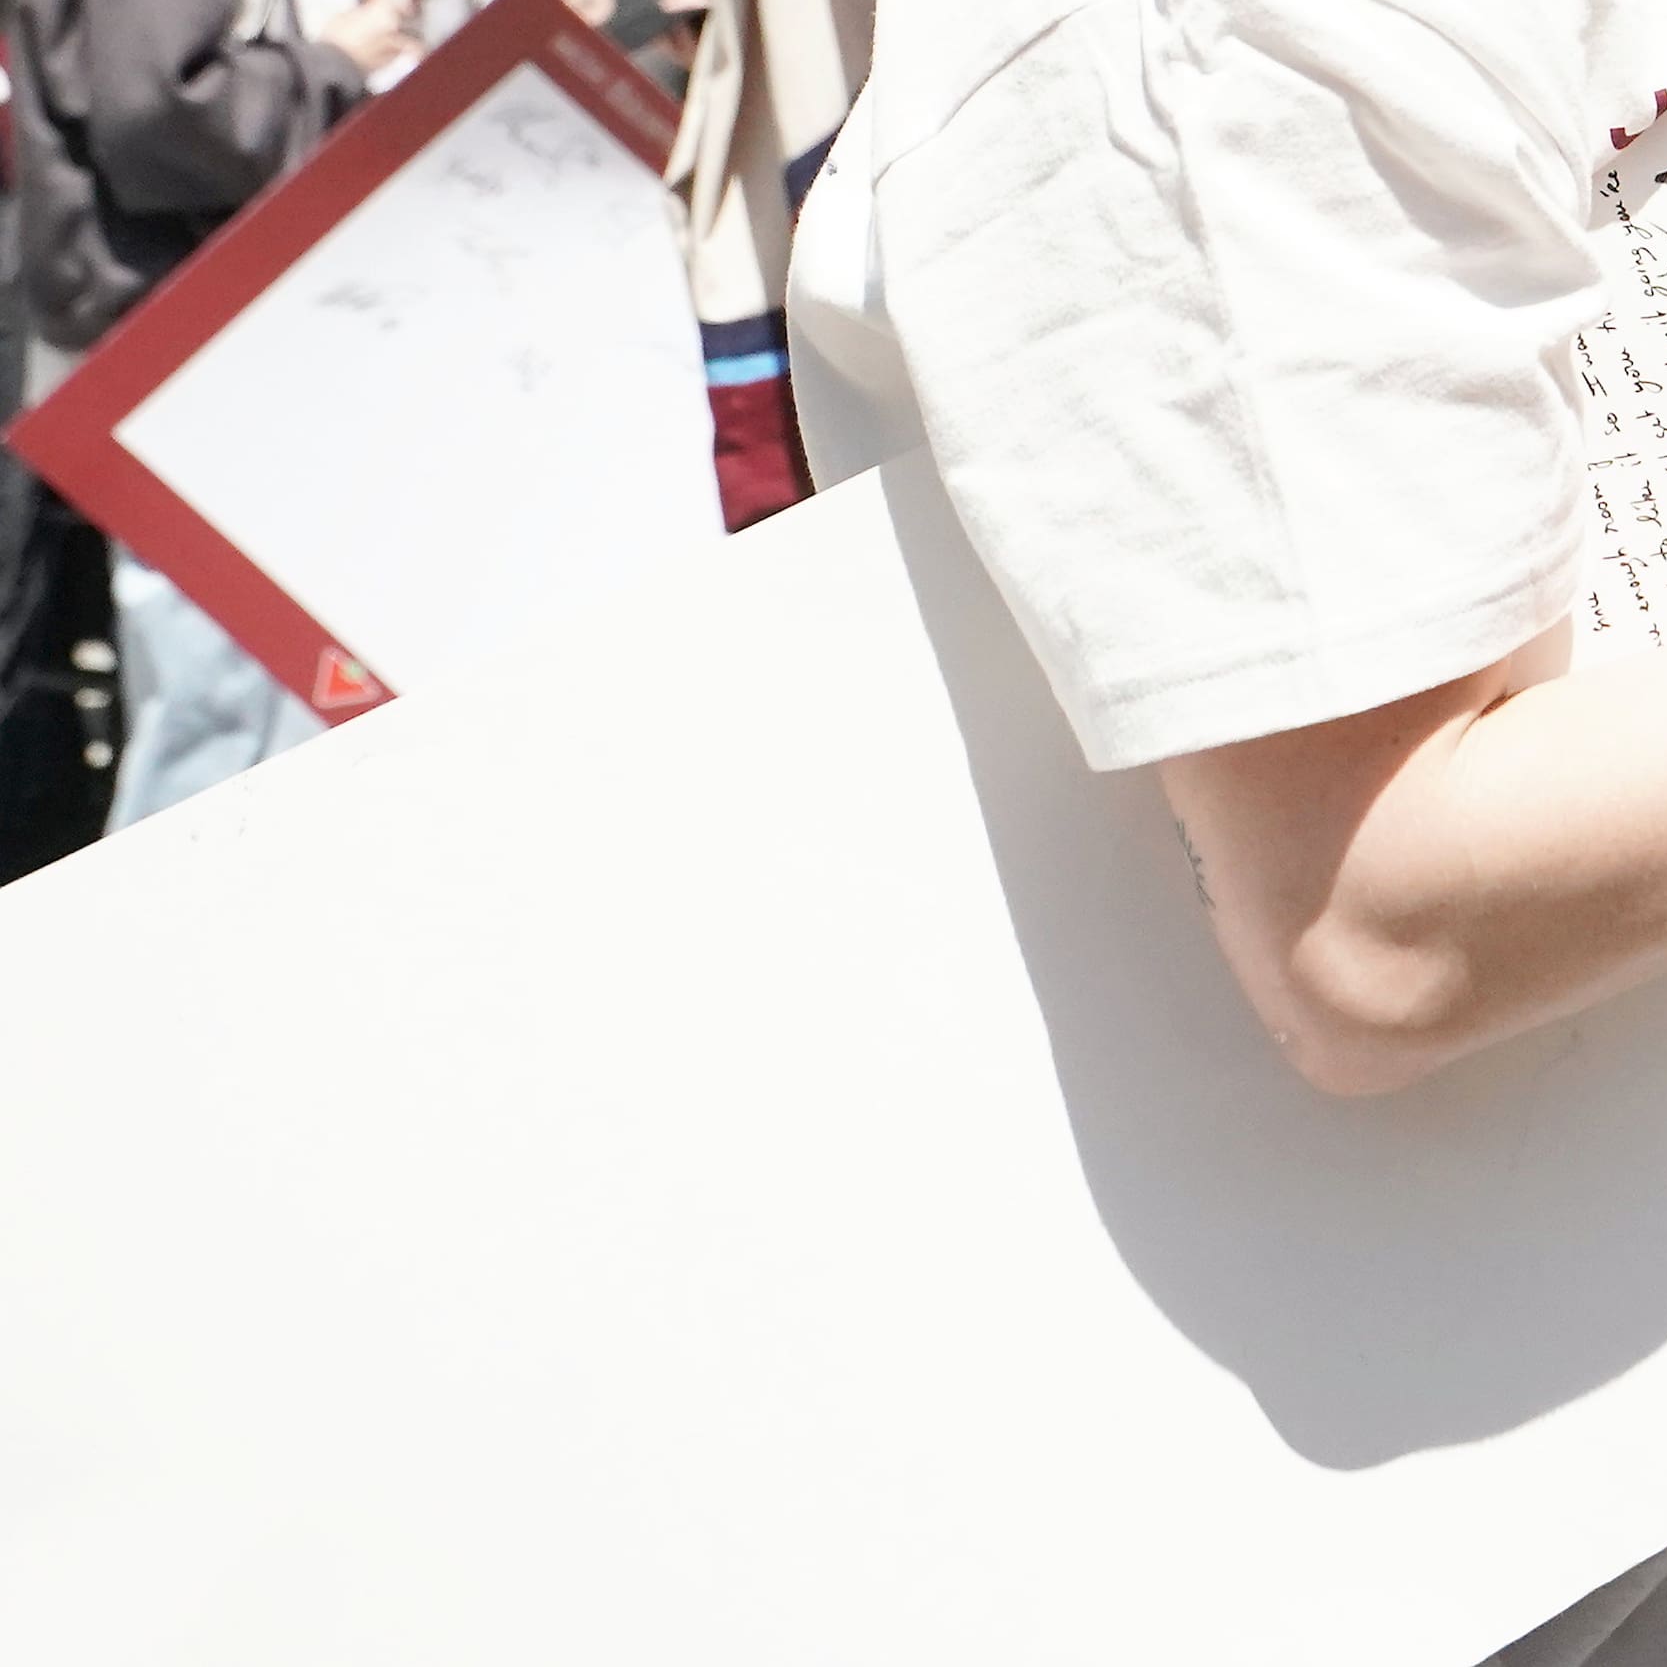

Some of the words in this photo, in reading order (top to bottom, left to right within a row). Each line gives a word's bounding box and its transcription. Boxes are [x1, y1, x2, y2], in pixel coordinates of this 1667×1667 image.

[1594, 483, 1619, 534] room
[1630, 479, 1662, 527] like
[1602, 547, 1649, 612] enough
